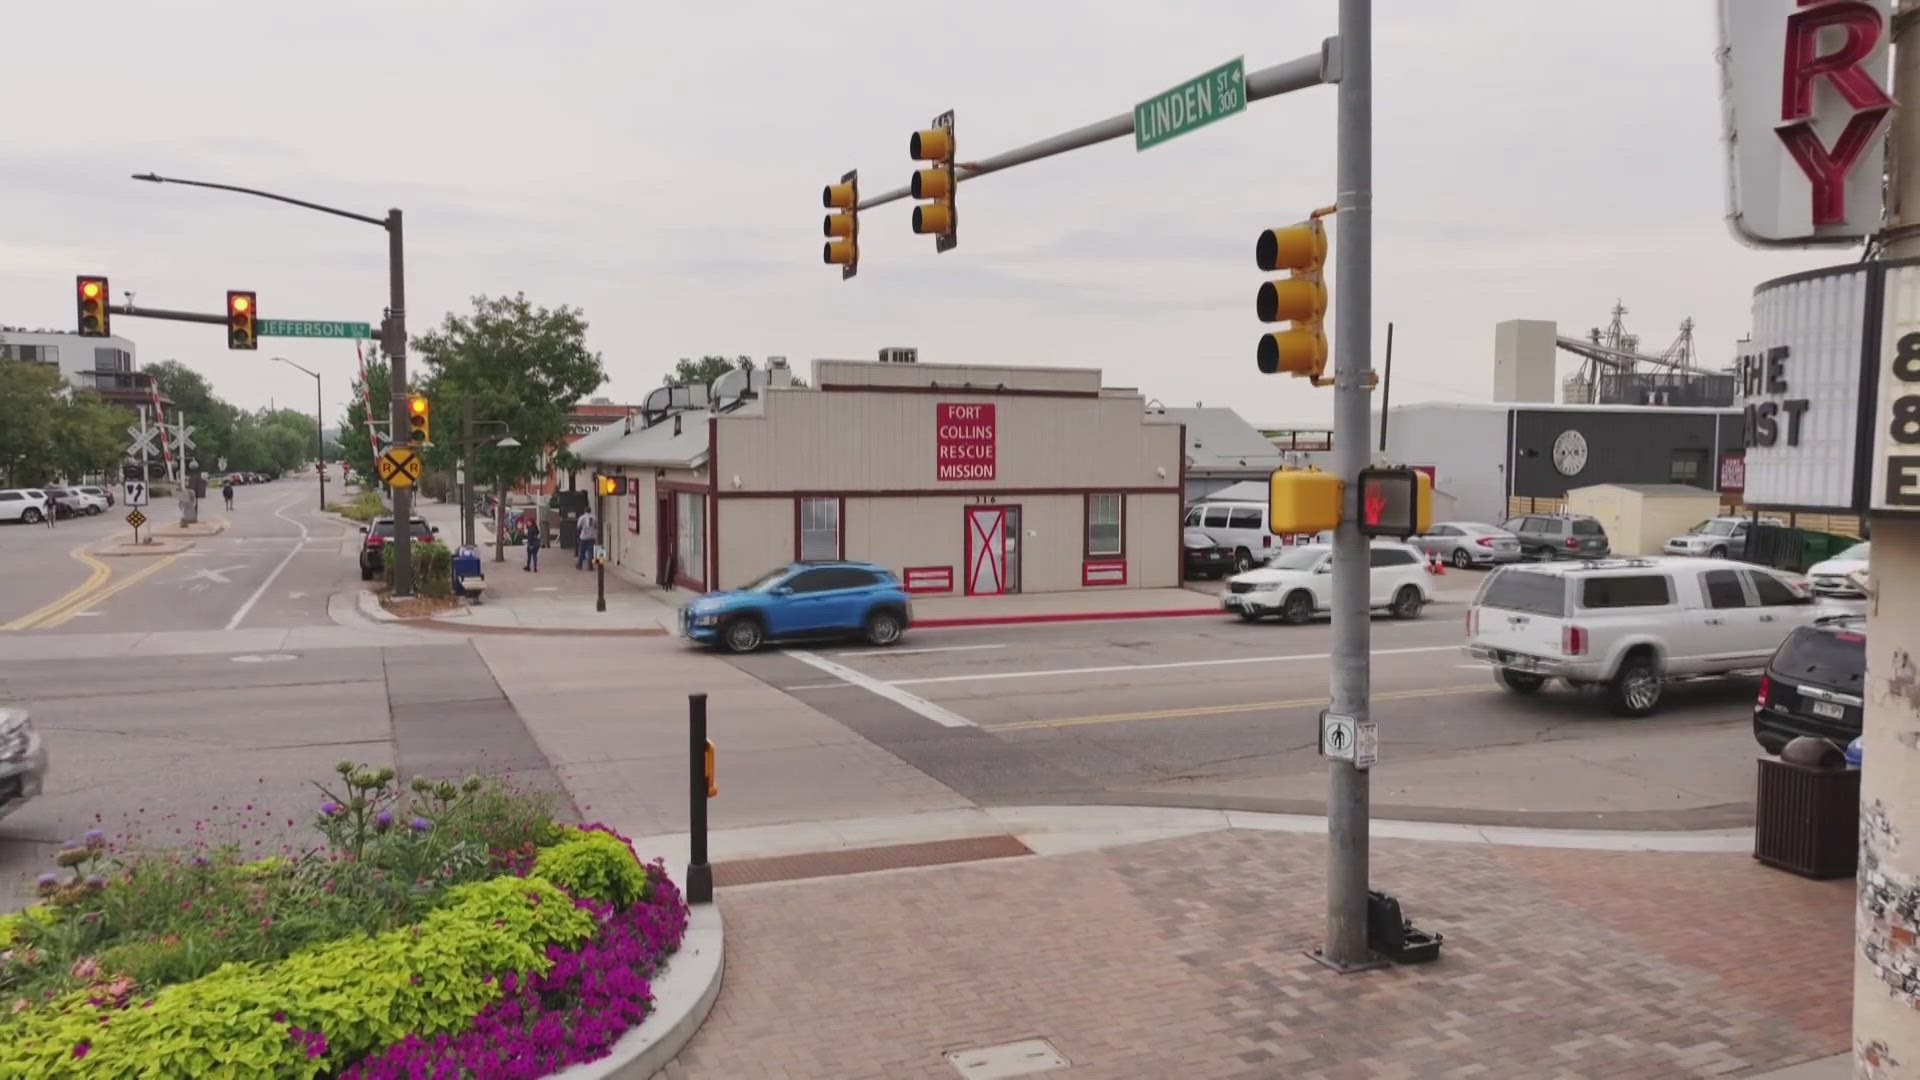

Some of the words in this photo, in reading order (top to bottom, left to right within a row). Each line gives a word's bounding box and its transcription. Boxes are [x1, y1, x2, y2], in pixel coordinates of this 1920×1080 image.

[1141, 78, 1212, 142] LINDEN
[1217, 71, 1228, 93] ST
[1219, 88, 1237, 113] 300
[1774, 0, 1893, 226] RY
[262, 321, 345, 337] JEFFERSON
[949, 405, 982, 420] FORT
[940, 425, 993, 440] COLLINS
[940, 445, 993, 459] RESCUE
[940, 464, 993, 479] MISSION
[975, 496, 996, 504] 316
